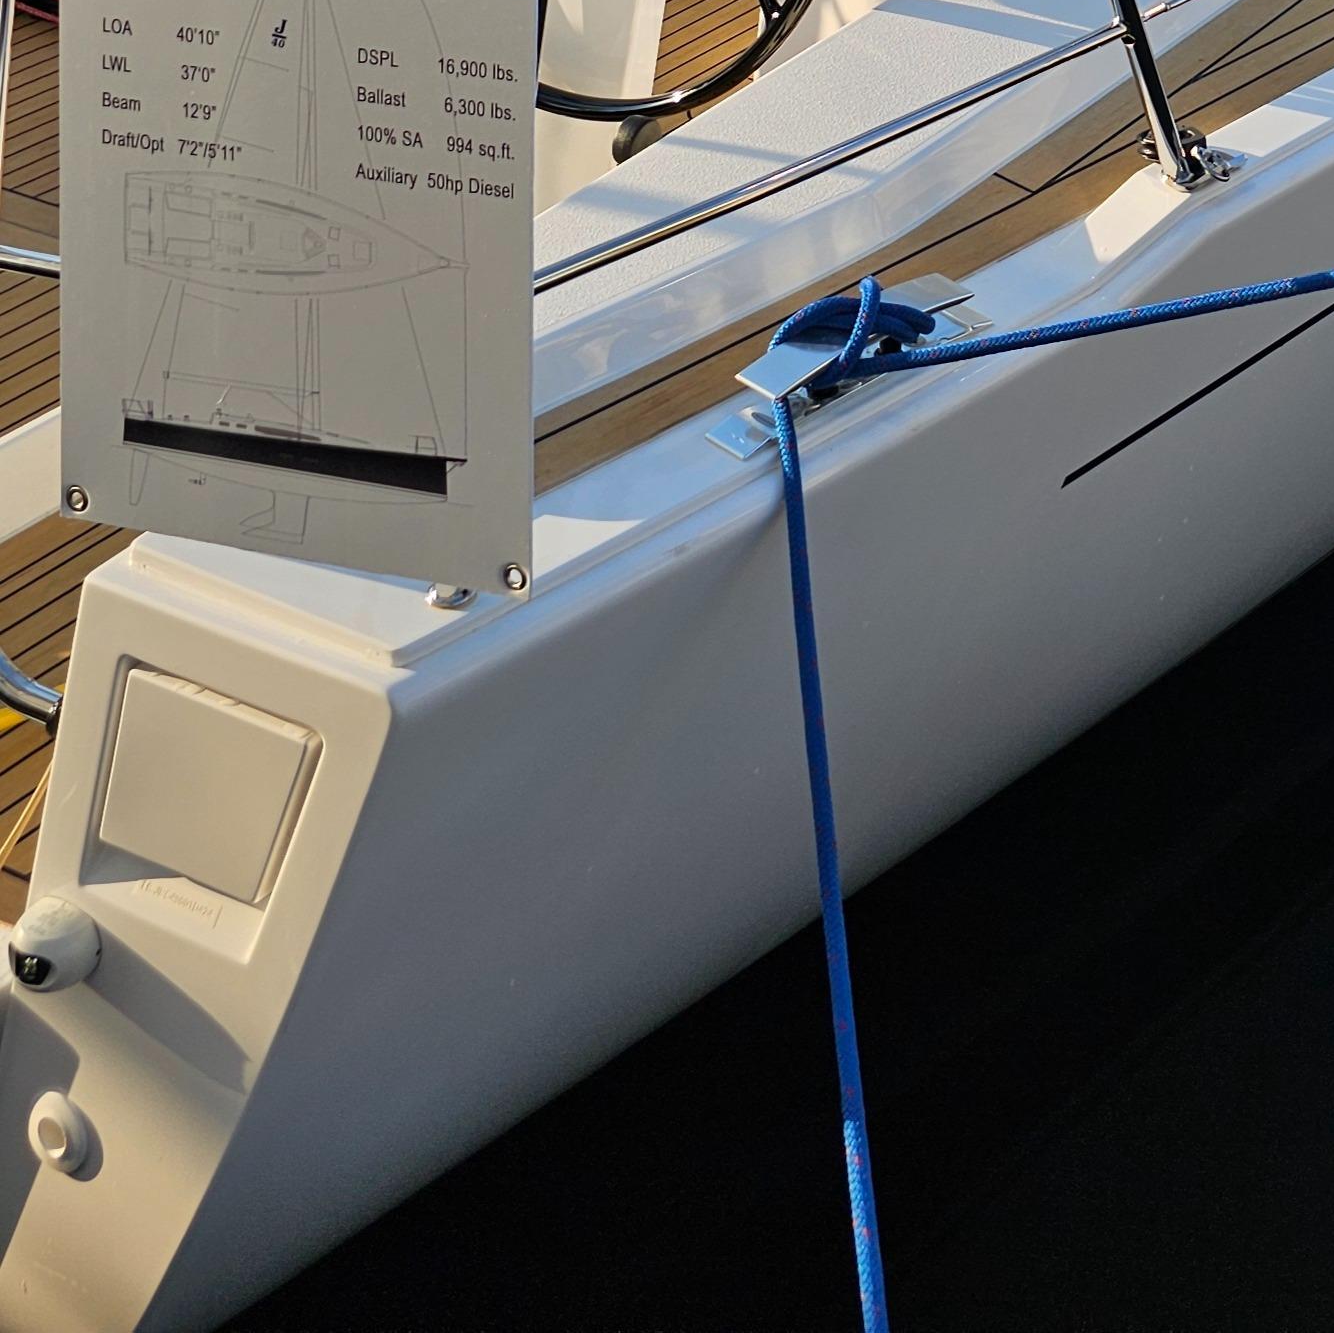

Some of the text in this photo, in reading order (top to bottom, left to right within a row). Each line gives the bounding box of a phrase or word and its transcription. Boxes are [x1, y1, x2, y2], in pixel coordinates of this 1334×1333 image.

[103, 18, 132, 35] LOA
[103, 55, 131, 72] LWL
[358, 48, 517, 82] DSPL 16,900 lbs.
[102, 92, 140, 111] Beam
[357, 86, 515, 121] Ballast 6,300 lbs.
[102, 129, 164, 154] Draft/Opt
[358, 125, 514, 161] 100% SA 994 sq.ft.
[356, 163, 513, 199] Auxiliary 50hp Diesel
